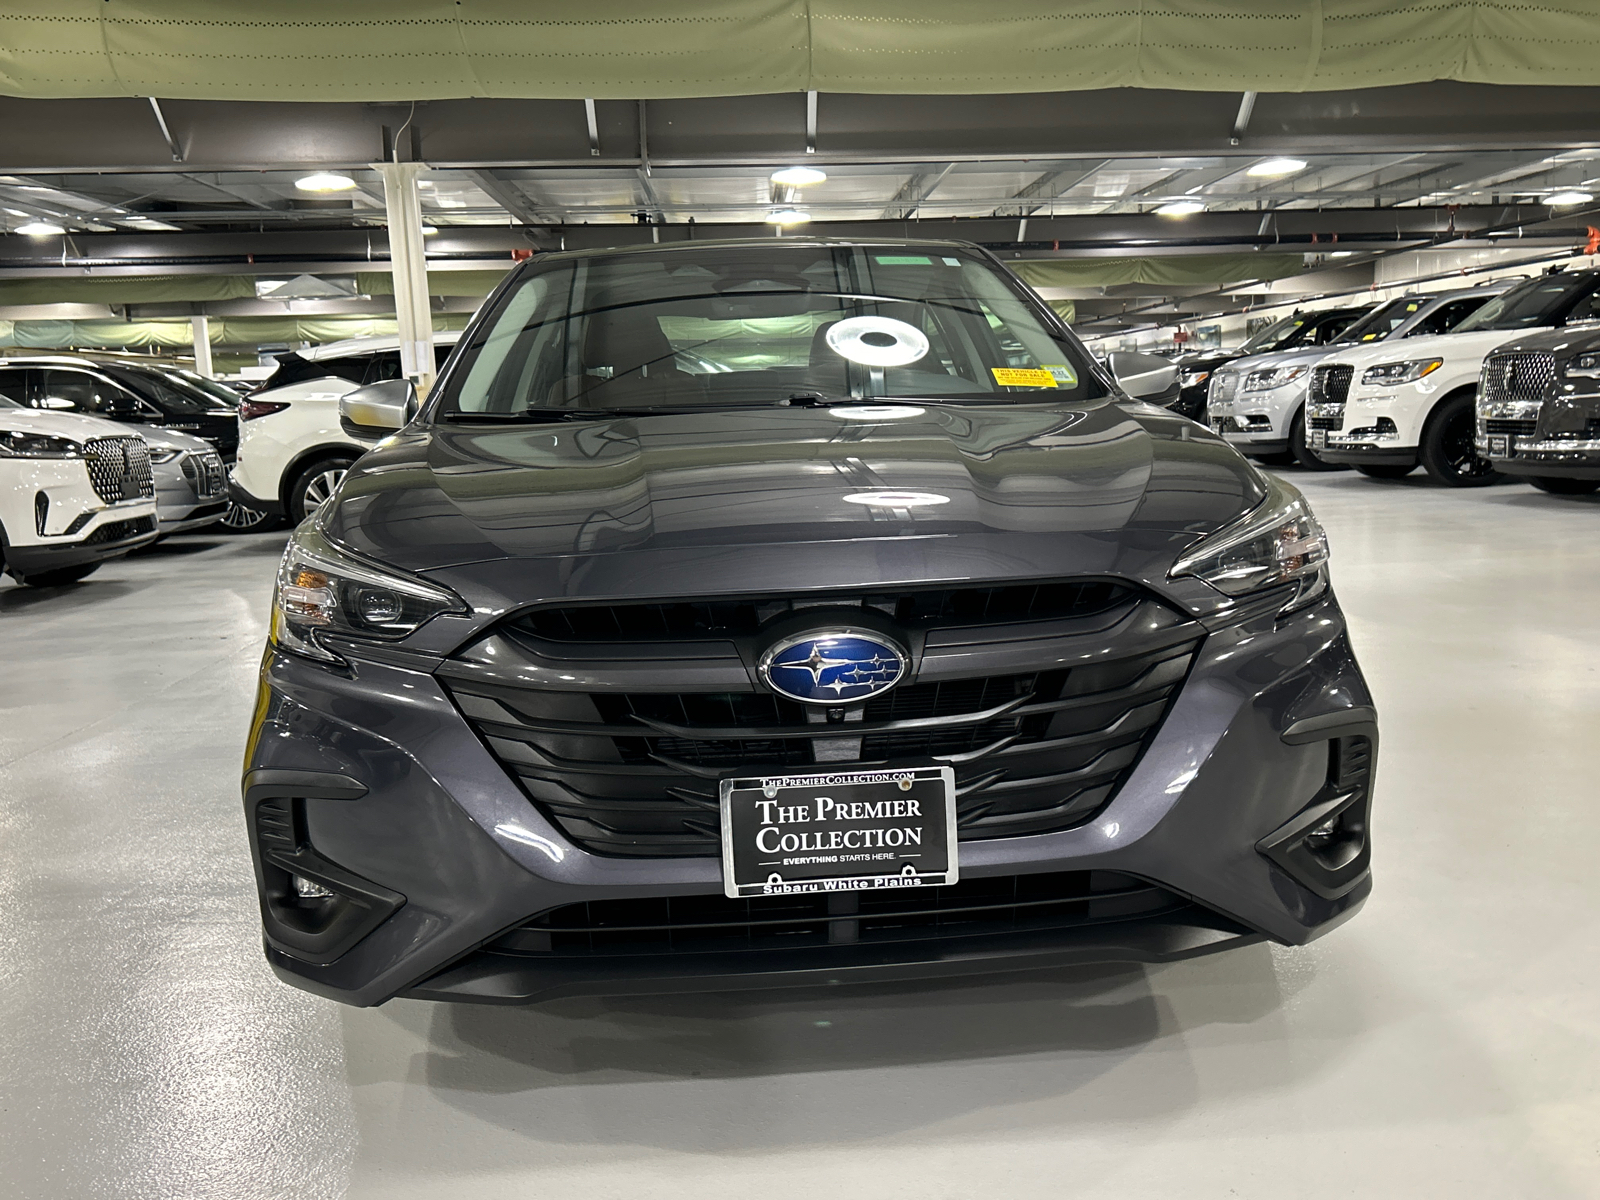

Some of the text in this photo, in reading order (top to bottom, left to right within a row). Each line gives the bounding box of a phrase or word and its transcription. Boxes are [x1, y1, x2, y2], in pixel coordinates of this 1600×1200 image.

[755, 797, 922, 825] THE PREMIER
[755, 827, 923, 854] COLLECTION
[783, 852, 897, 866] EVERYTHING STARTS HERE.
[763, 877, 922, 894] Subaru White Plains
